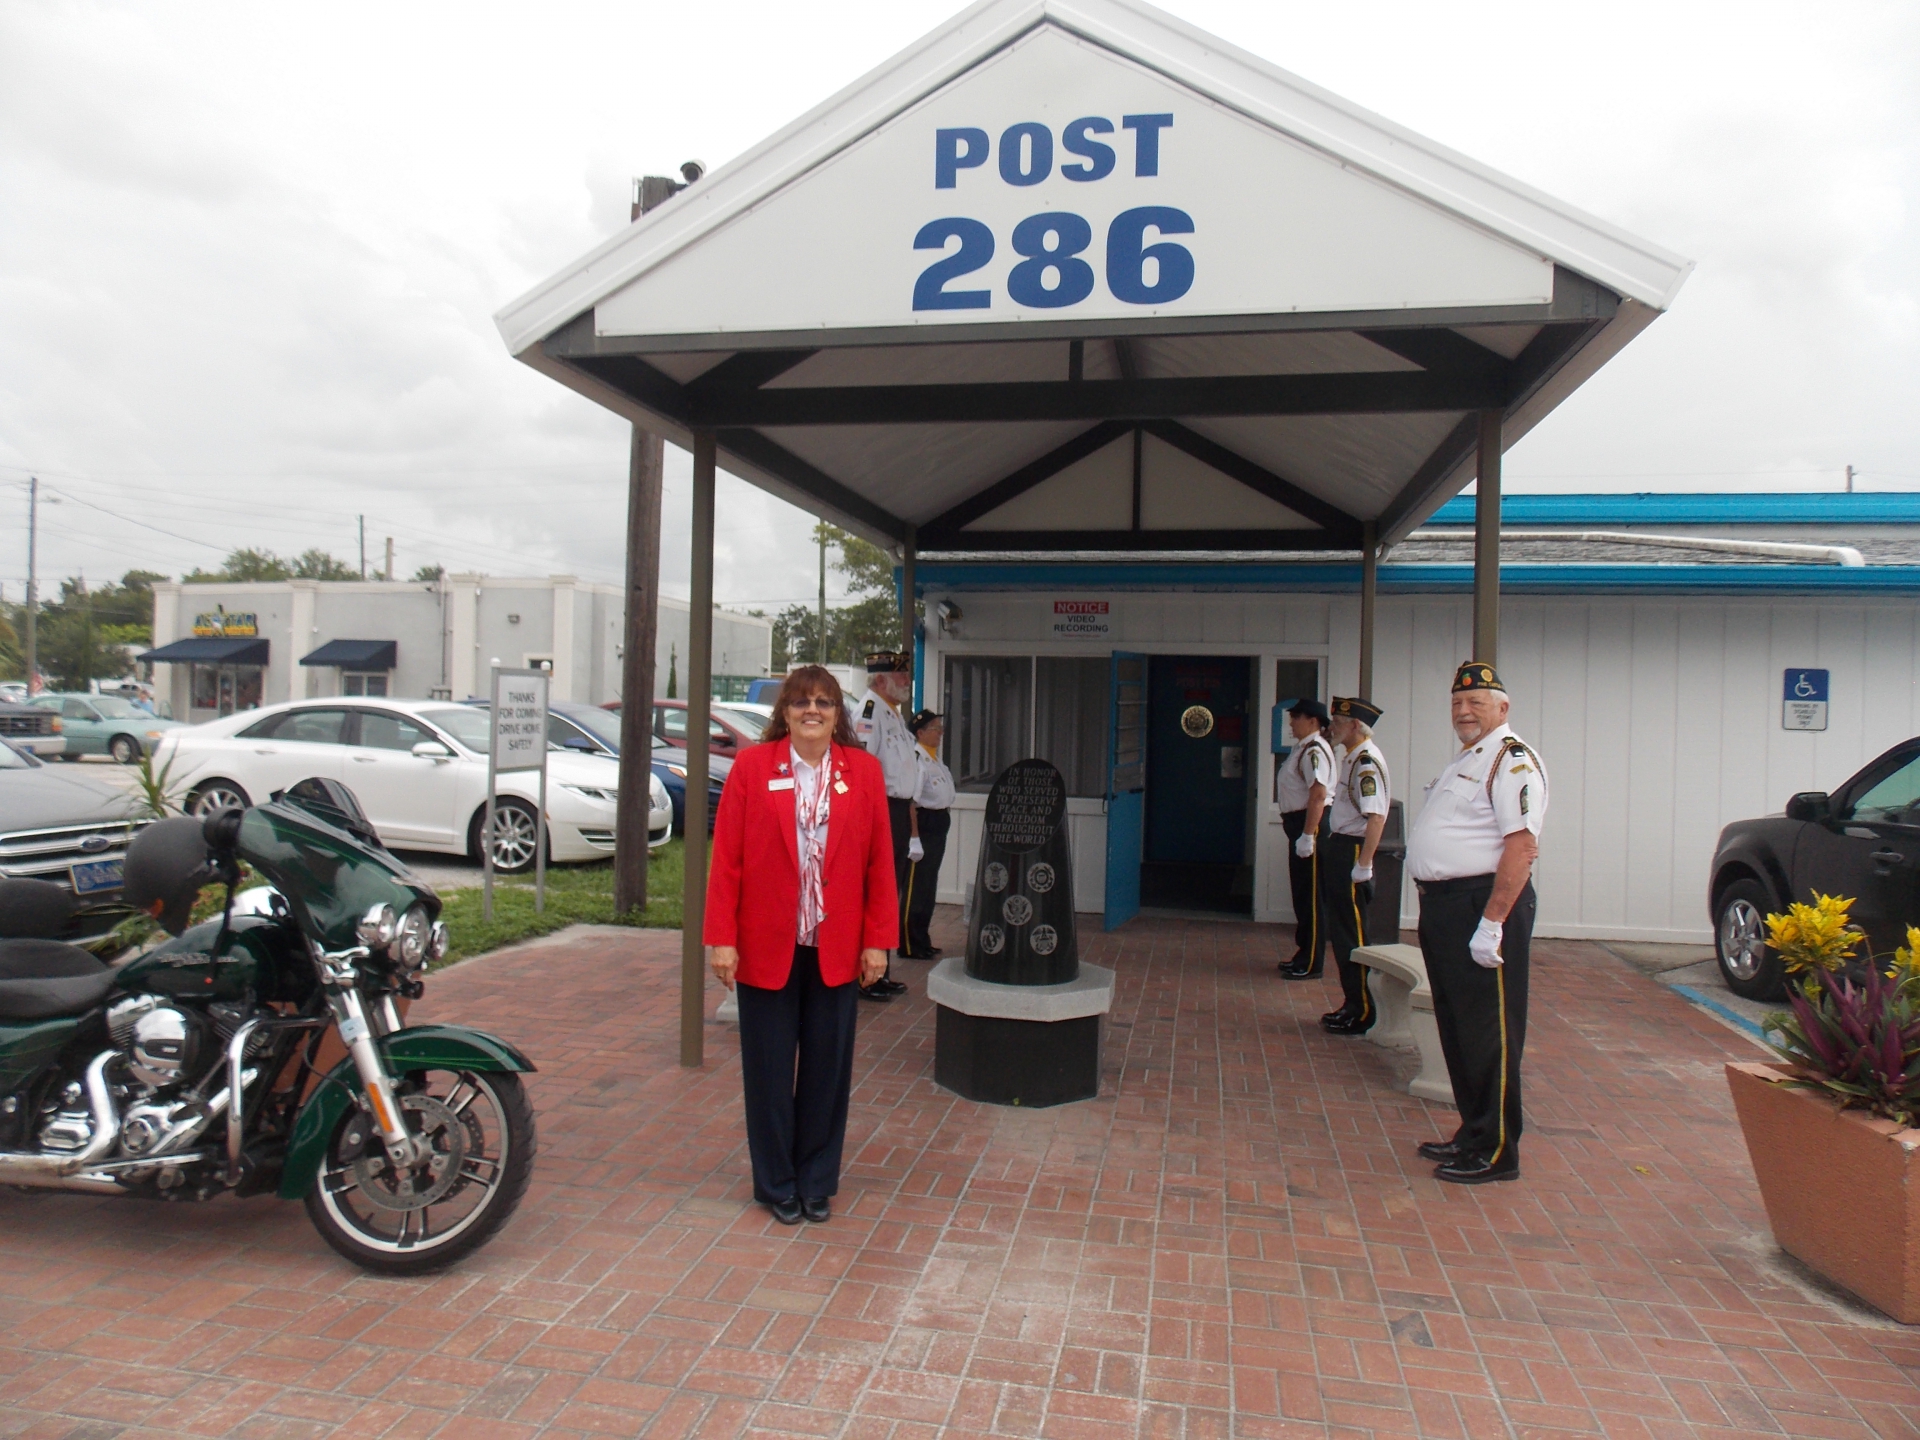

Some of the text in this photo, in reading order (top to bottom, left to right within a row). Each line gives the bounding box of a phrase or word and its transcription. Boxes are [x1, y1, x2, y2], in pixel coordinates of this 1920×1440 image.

[934, 113, 1174, 190] POST
[911, 205, 1196, 312] 286
[1057, 602, 1106, 613] NOTICE
[1067, 615, 1096, 623] VIDEO
[1053, 624, 1109, 633] RECORDING
[508, 692, 535, 703] THANKS
[499, 708, 542, 718] FOR COMING
[499, 724, 541, 734] DRIVE HOME
[508, 739, 533, 750] SAFELY
[1008, 767, 1057, 777] IN HONOR
[1007, 777, 1053, 786] OF THOSE
[999, 786, 1059, 796] WHO SERVED
[996, 795, 1058, 806] TO PRESERVE
[998, 804, 1052, 815] PEACE AND
[1001, 814, 1046, 825] FREEDOM
[989, 822, 1055, 835] THROUGHOUT
[992, 833, 1046, 845] THE WORLD
